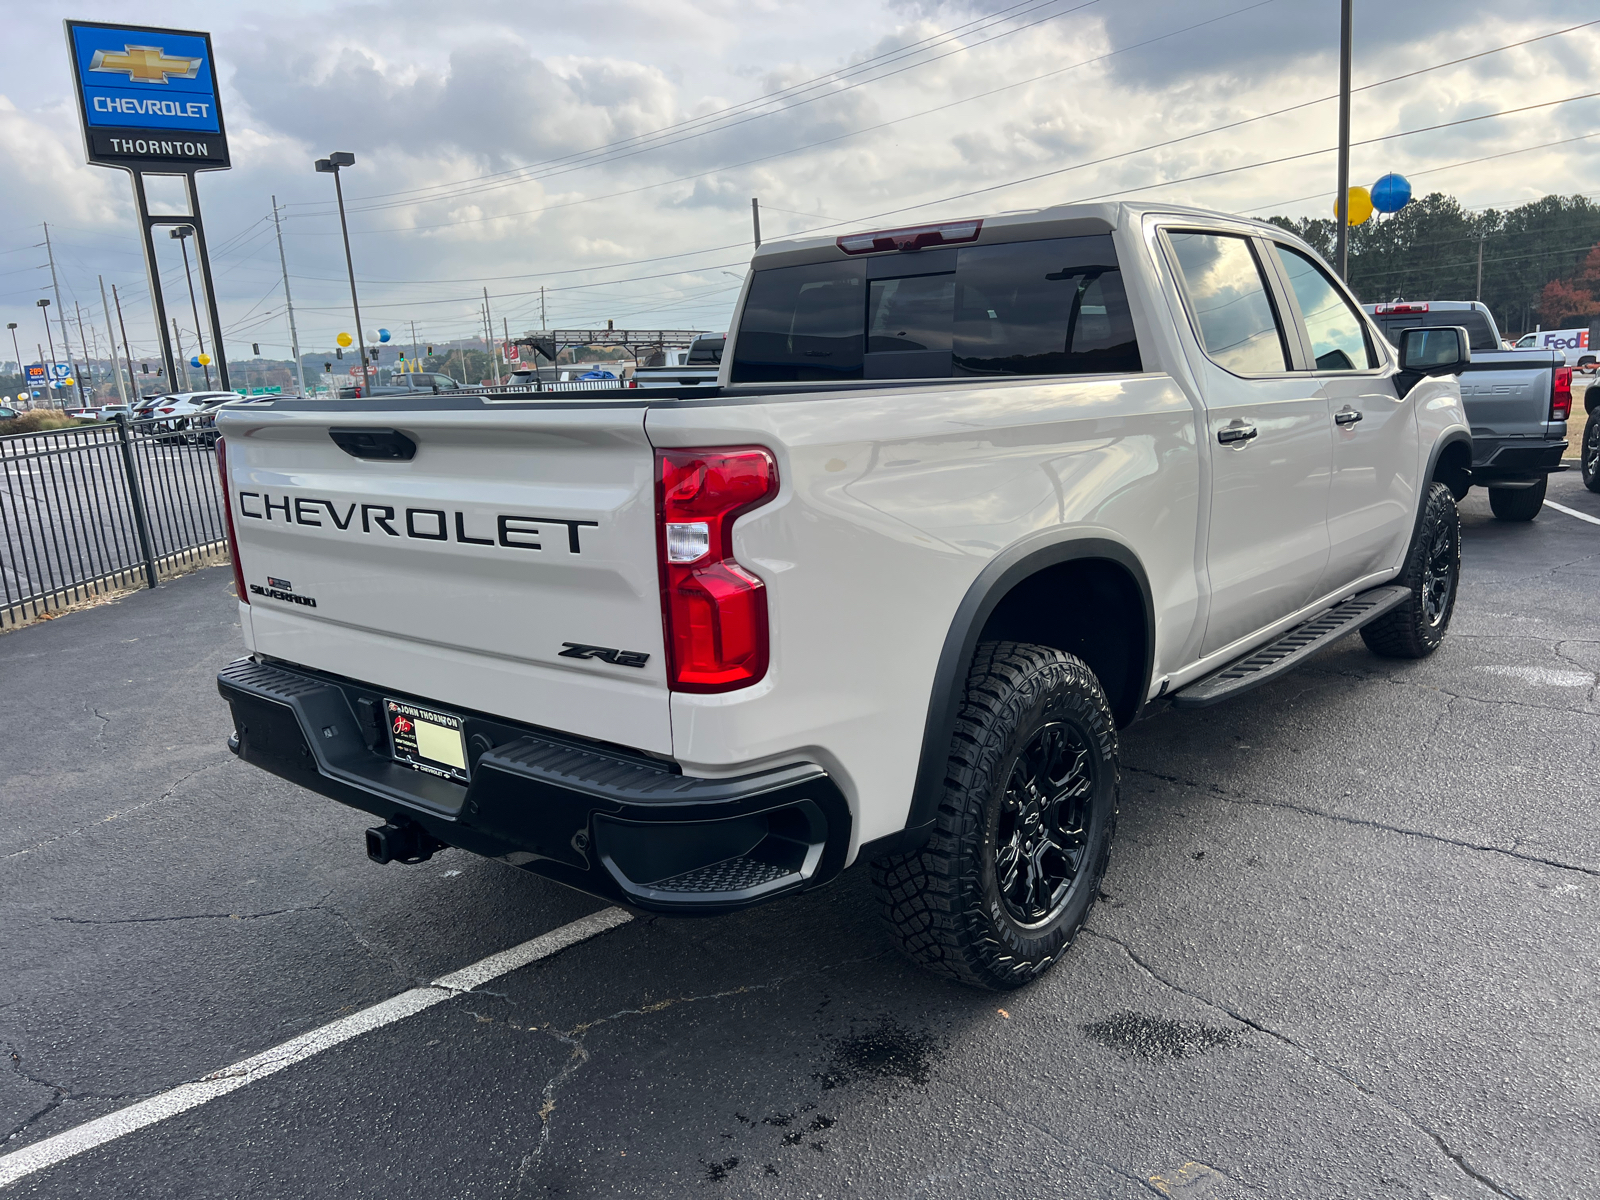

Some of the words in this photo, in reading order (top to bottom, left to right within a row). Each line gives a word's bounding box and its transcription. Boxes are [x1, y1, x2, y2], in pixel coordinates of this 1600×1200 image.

[93, 96, 209, 118] CHEVROLET
[110, 138, 208, 156] THORNTON
[1544, 331, 1589, 349] FedE
[239, 491, 599, 555] CHEVROLET
[249, 584, 317, 607] SILVERADO
[557, 641, 651, 668] ZR2
[400, 705, 419, 717] JOHN
[419, 710, 458, 728] THORNTON
[1042, 691, 1112, 762] GOODYEAR
